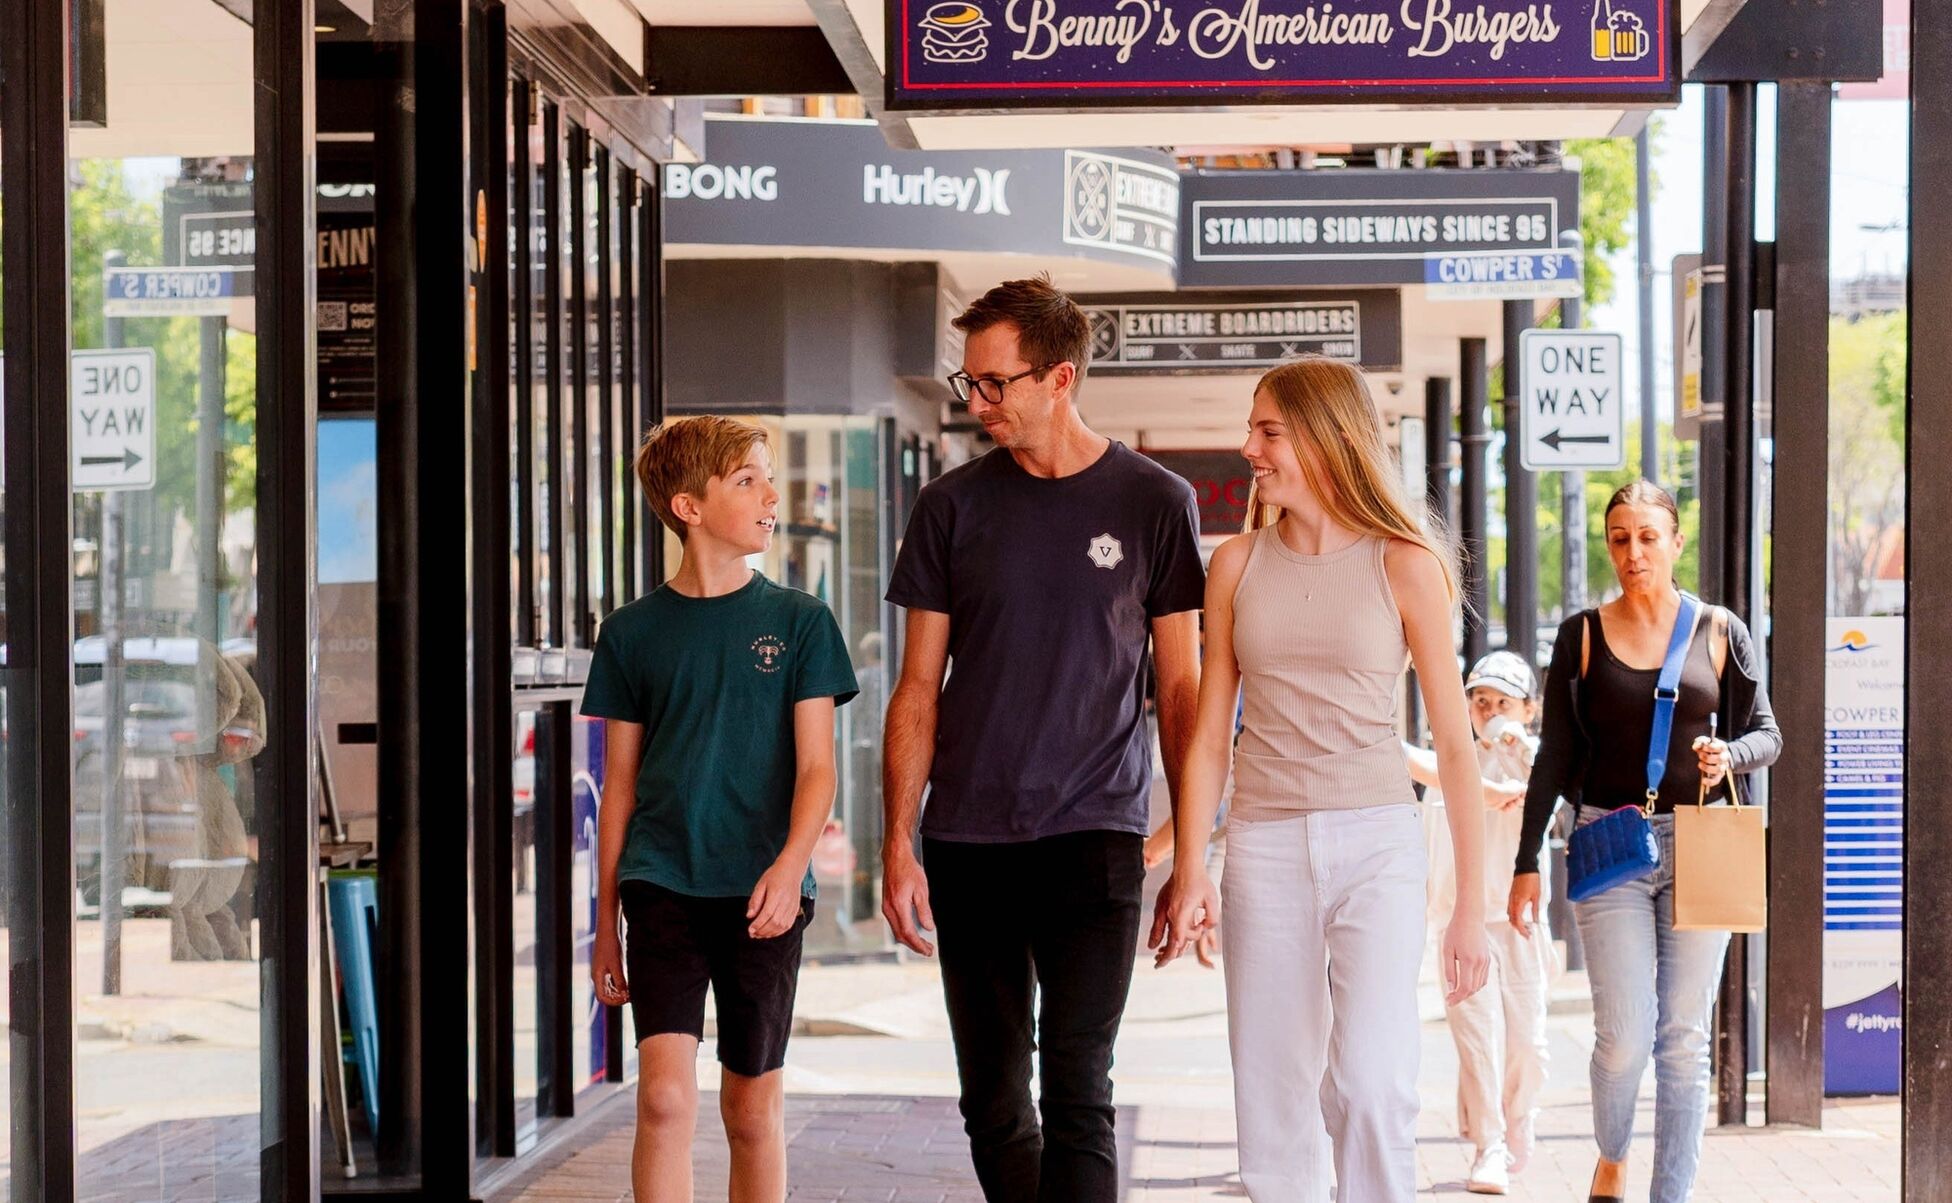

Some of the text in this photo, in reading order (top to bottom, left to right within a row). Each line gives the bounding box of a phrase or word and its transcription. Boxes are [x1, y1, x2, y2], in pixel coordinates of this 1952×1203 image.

[1005, 0, 1561, 70] Benny's American Burgers
[661, 164, 778, 201] BONG
[863, 163, 978, 213] Hurley
[1204, 217, 1318, 245] STANDING
[1322, 215, 1438, 244] SIDEWAYS
[1442, 214, 1512, 242] SINCE
[1515, 214, 1547, 241] 95
[1439, 256, 1534, 282] COWPER
[1126, 310, 1355, 337] EXTREME BOARDRIDERS
[1541, 346, 1606, 374] ONE
[1536, 387, 1610, 415] WAY
[1100, 546, 1112, 557] V
